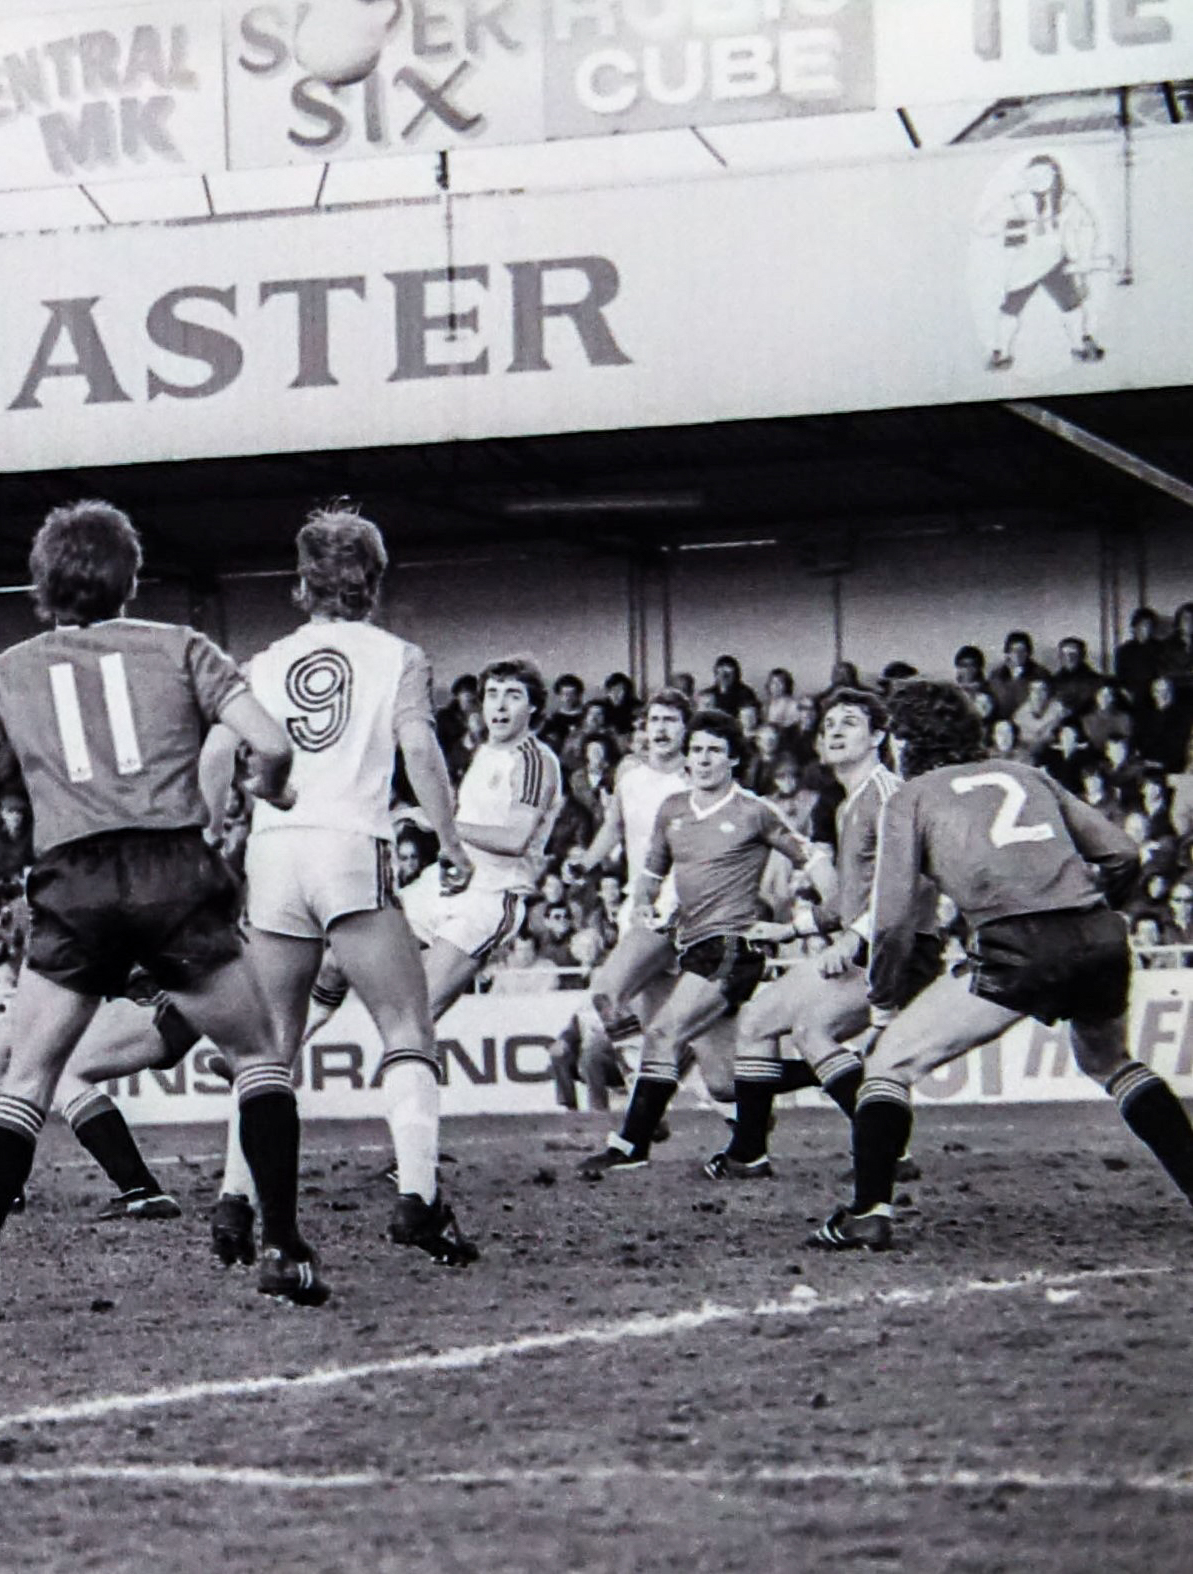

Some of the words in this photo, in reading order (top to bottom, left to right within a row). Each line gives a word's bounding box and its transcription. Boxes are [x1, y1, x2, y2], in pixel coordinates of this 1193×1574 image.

[287, 60, 486, 148] SIX
[576, 28, 843, 114] CUBE
[38, 95, 185, 177] MK
[49, 652, 144, 783] 11
[286, 648, 354, 754] 9
[949, 771, 1055, 849] 2
